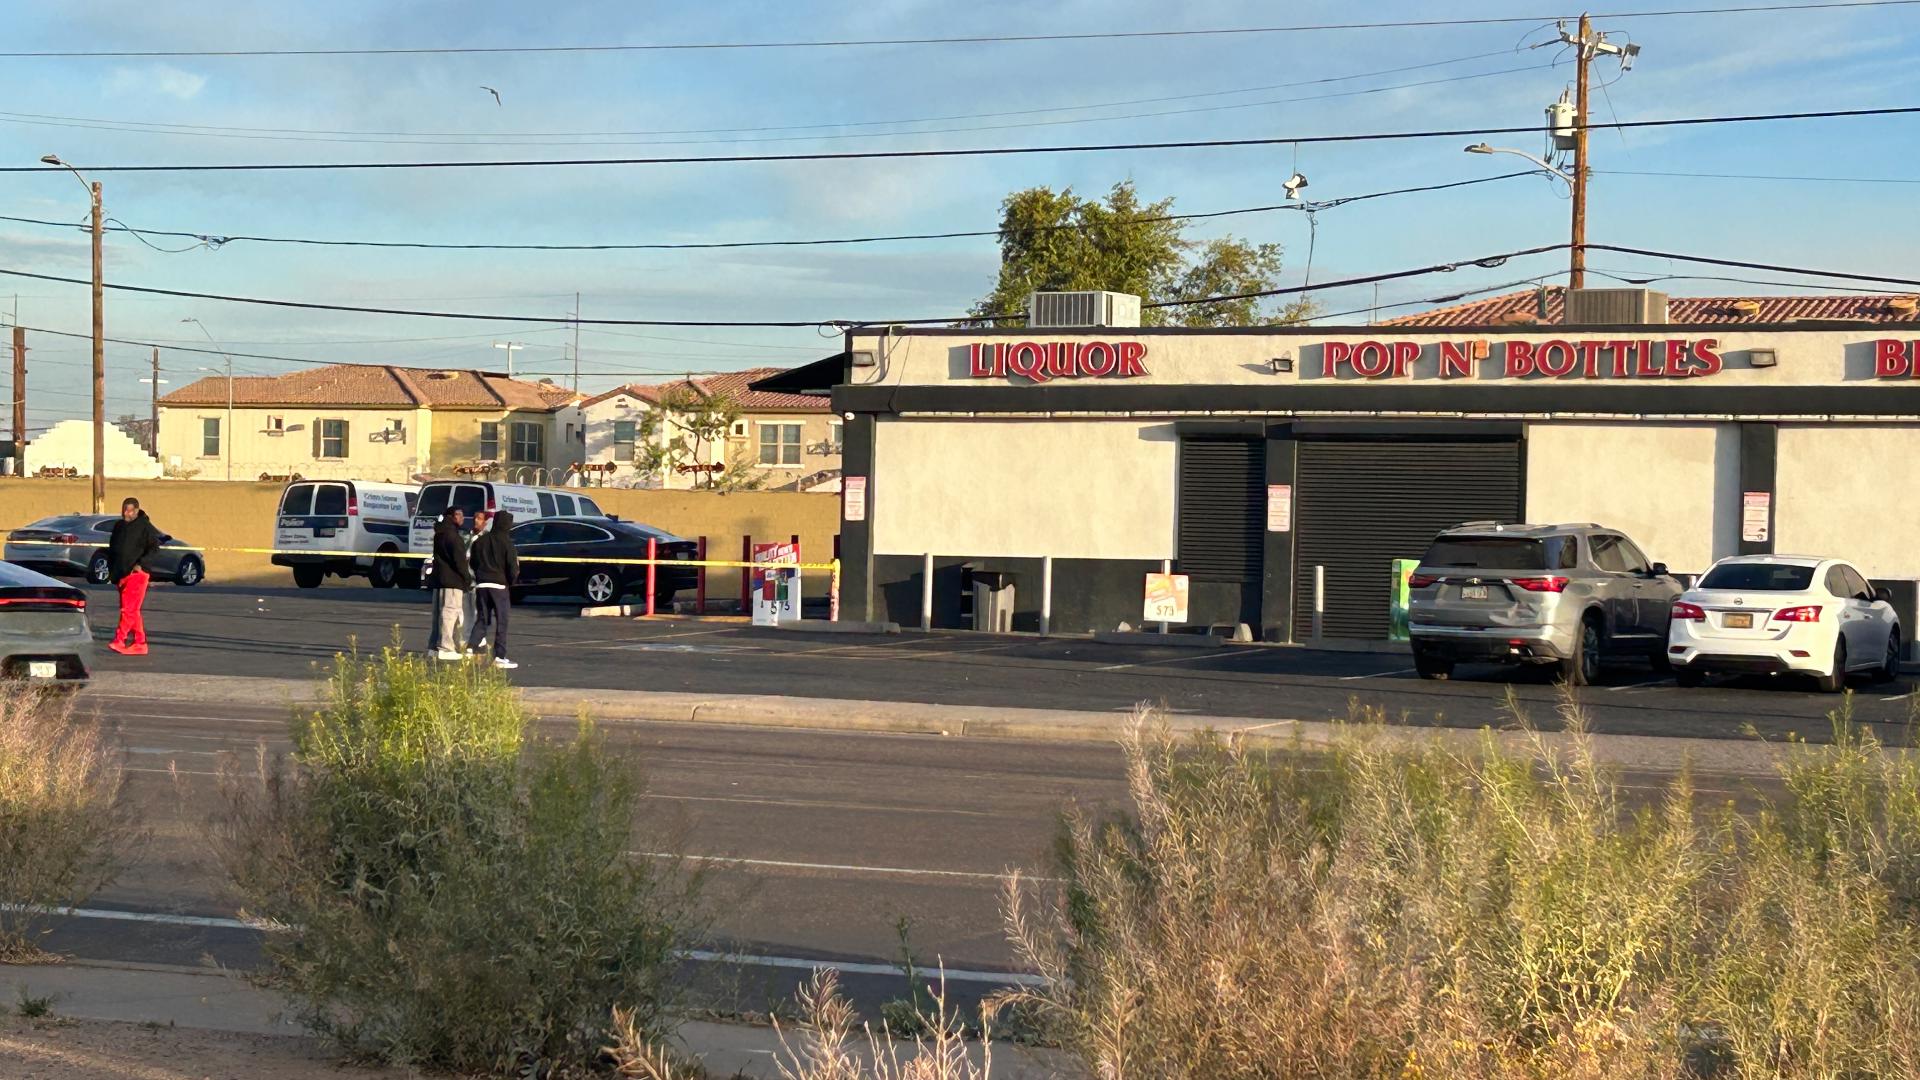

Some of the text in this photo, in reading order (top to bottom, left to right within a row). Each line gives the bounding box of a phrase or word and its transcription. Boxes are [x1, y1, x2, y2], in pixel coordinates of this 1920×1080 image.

[969, 341, 1151, 382] LIQUOR
[1322, 340, 1422, 377] POP
[1503, 338, 1725, 378] BOTTLES
[1873, 338, 1920, 377] B
